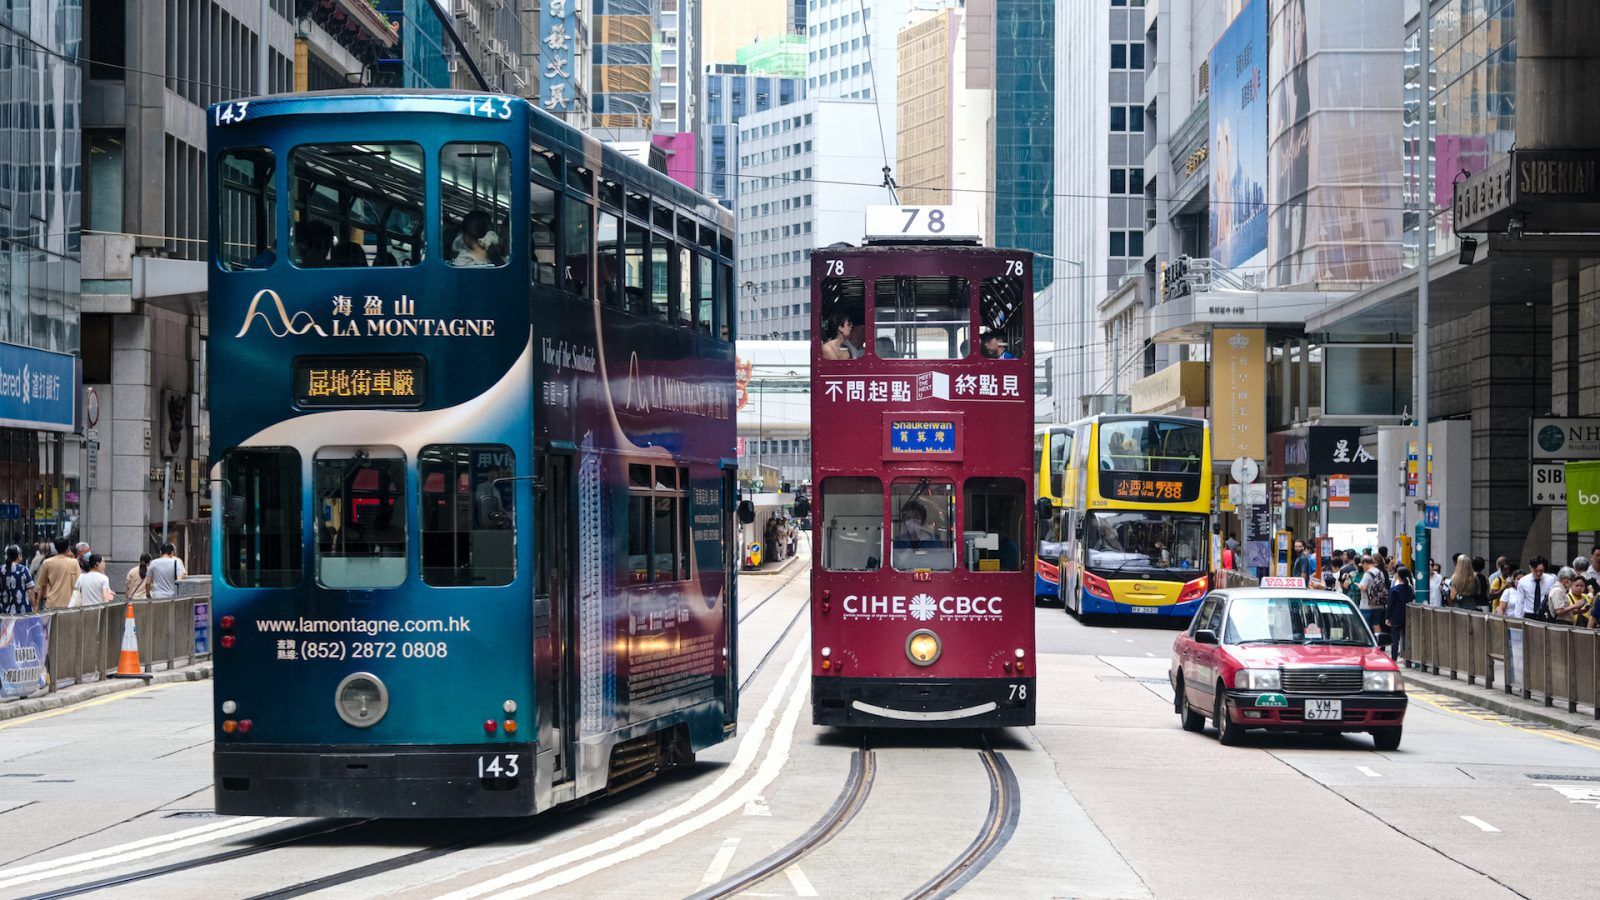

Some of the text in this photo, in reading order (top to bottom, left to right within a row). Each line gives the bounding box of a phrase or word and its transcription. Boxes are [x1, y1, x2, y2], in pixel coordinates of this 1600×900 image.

[215, 101, 249, 126] 143
[469, 97, 513, 120] 143
[1521, 160, 1595, 194] SIBERIAN
[901, 208, 945, 233] 78
[826, 260, 844, 276] 78
[1005, 260, 1024, 276] 78
[332, 294, 415, 316] 海盈山
[332, 319, 495, 337] LA MONTAGNE
[308, 369, 415, 396] 屈地街車廠
[825, 380, 911, 402] 不問起點
[955, 373, 1020, 397] 終點見
[893, 422, 952, 430] Shaukeiwan
[1537, 469, 1566, 483] SIB
[1156, 487, 1182, 499] 788
[1265, 578, 1302, 587] TAXI
[843, 595, 906, 614] CIHE
[939, 596, 1002, 615] CBCC
[256, 616, 471, 636] www.lamontagne.com.hk
[301, 641, 447, 660] (852) 2872 0808
[1008, 684, 1027, 700] 78
[1307, 710, 1339, 719] 6777
[1315, 700, 1331, 710] VM
[478, 754, 519, 778] 143
